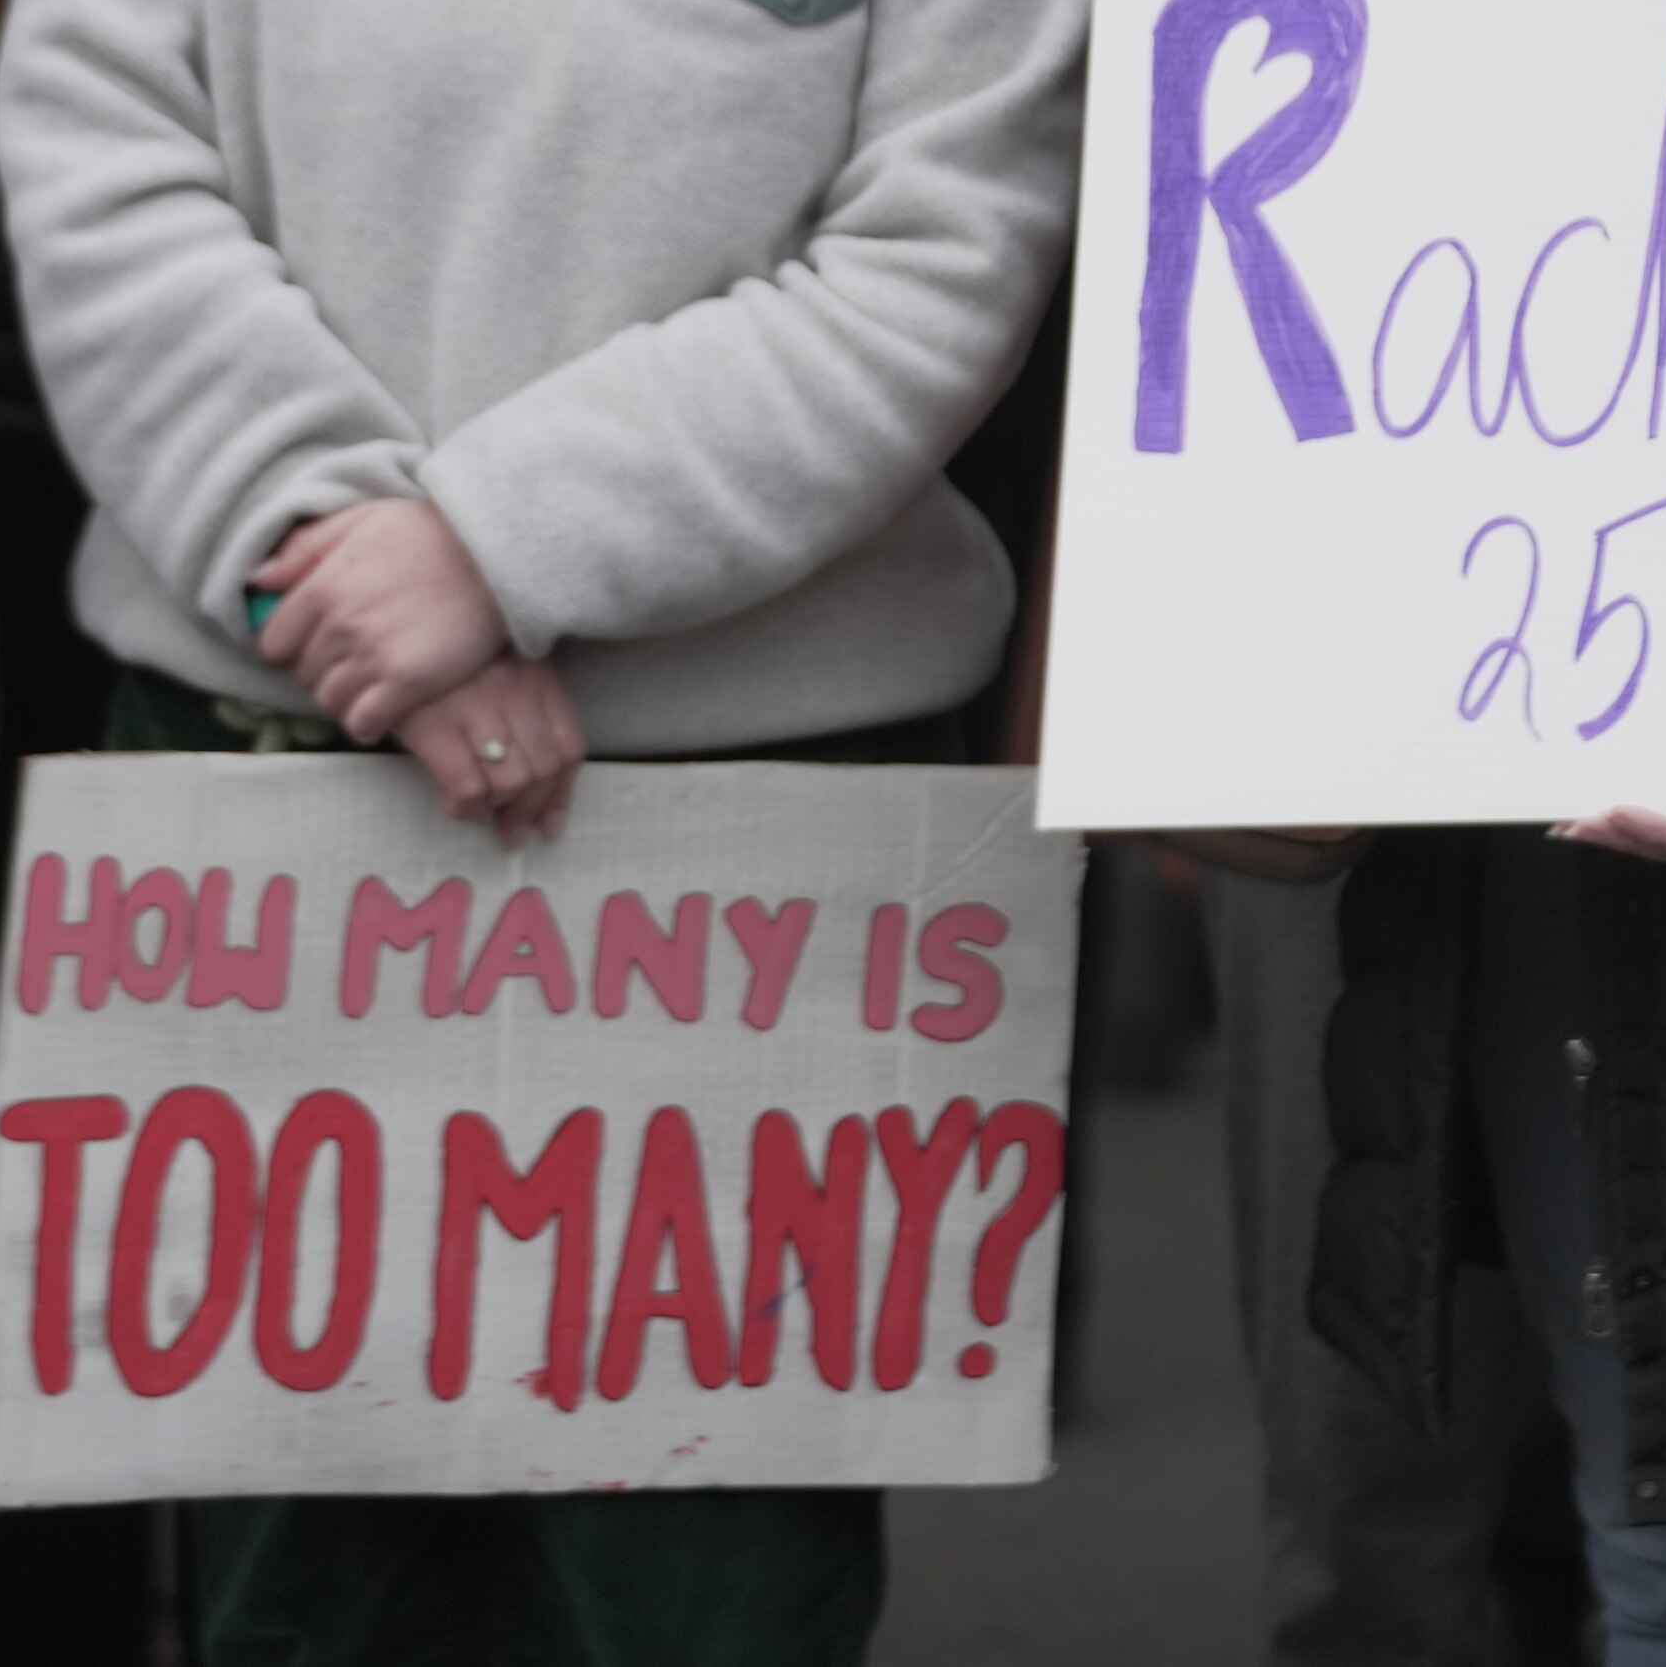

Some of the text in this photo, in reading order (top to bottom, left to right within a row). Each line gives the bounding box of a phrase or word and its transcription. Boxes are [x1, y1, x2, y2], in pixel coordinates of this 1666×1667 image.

[17, 852, 1008, 1042] HOW MANY IS
[429, 1096, 1066, 1411] MANY?
